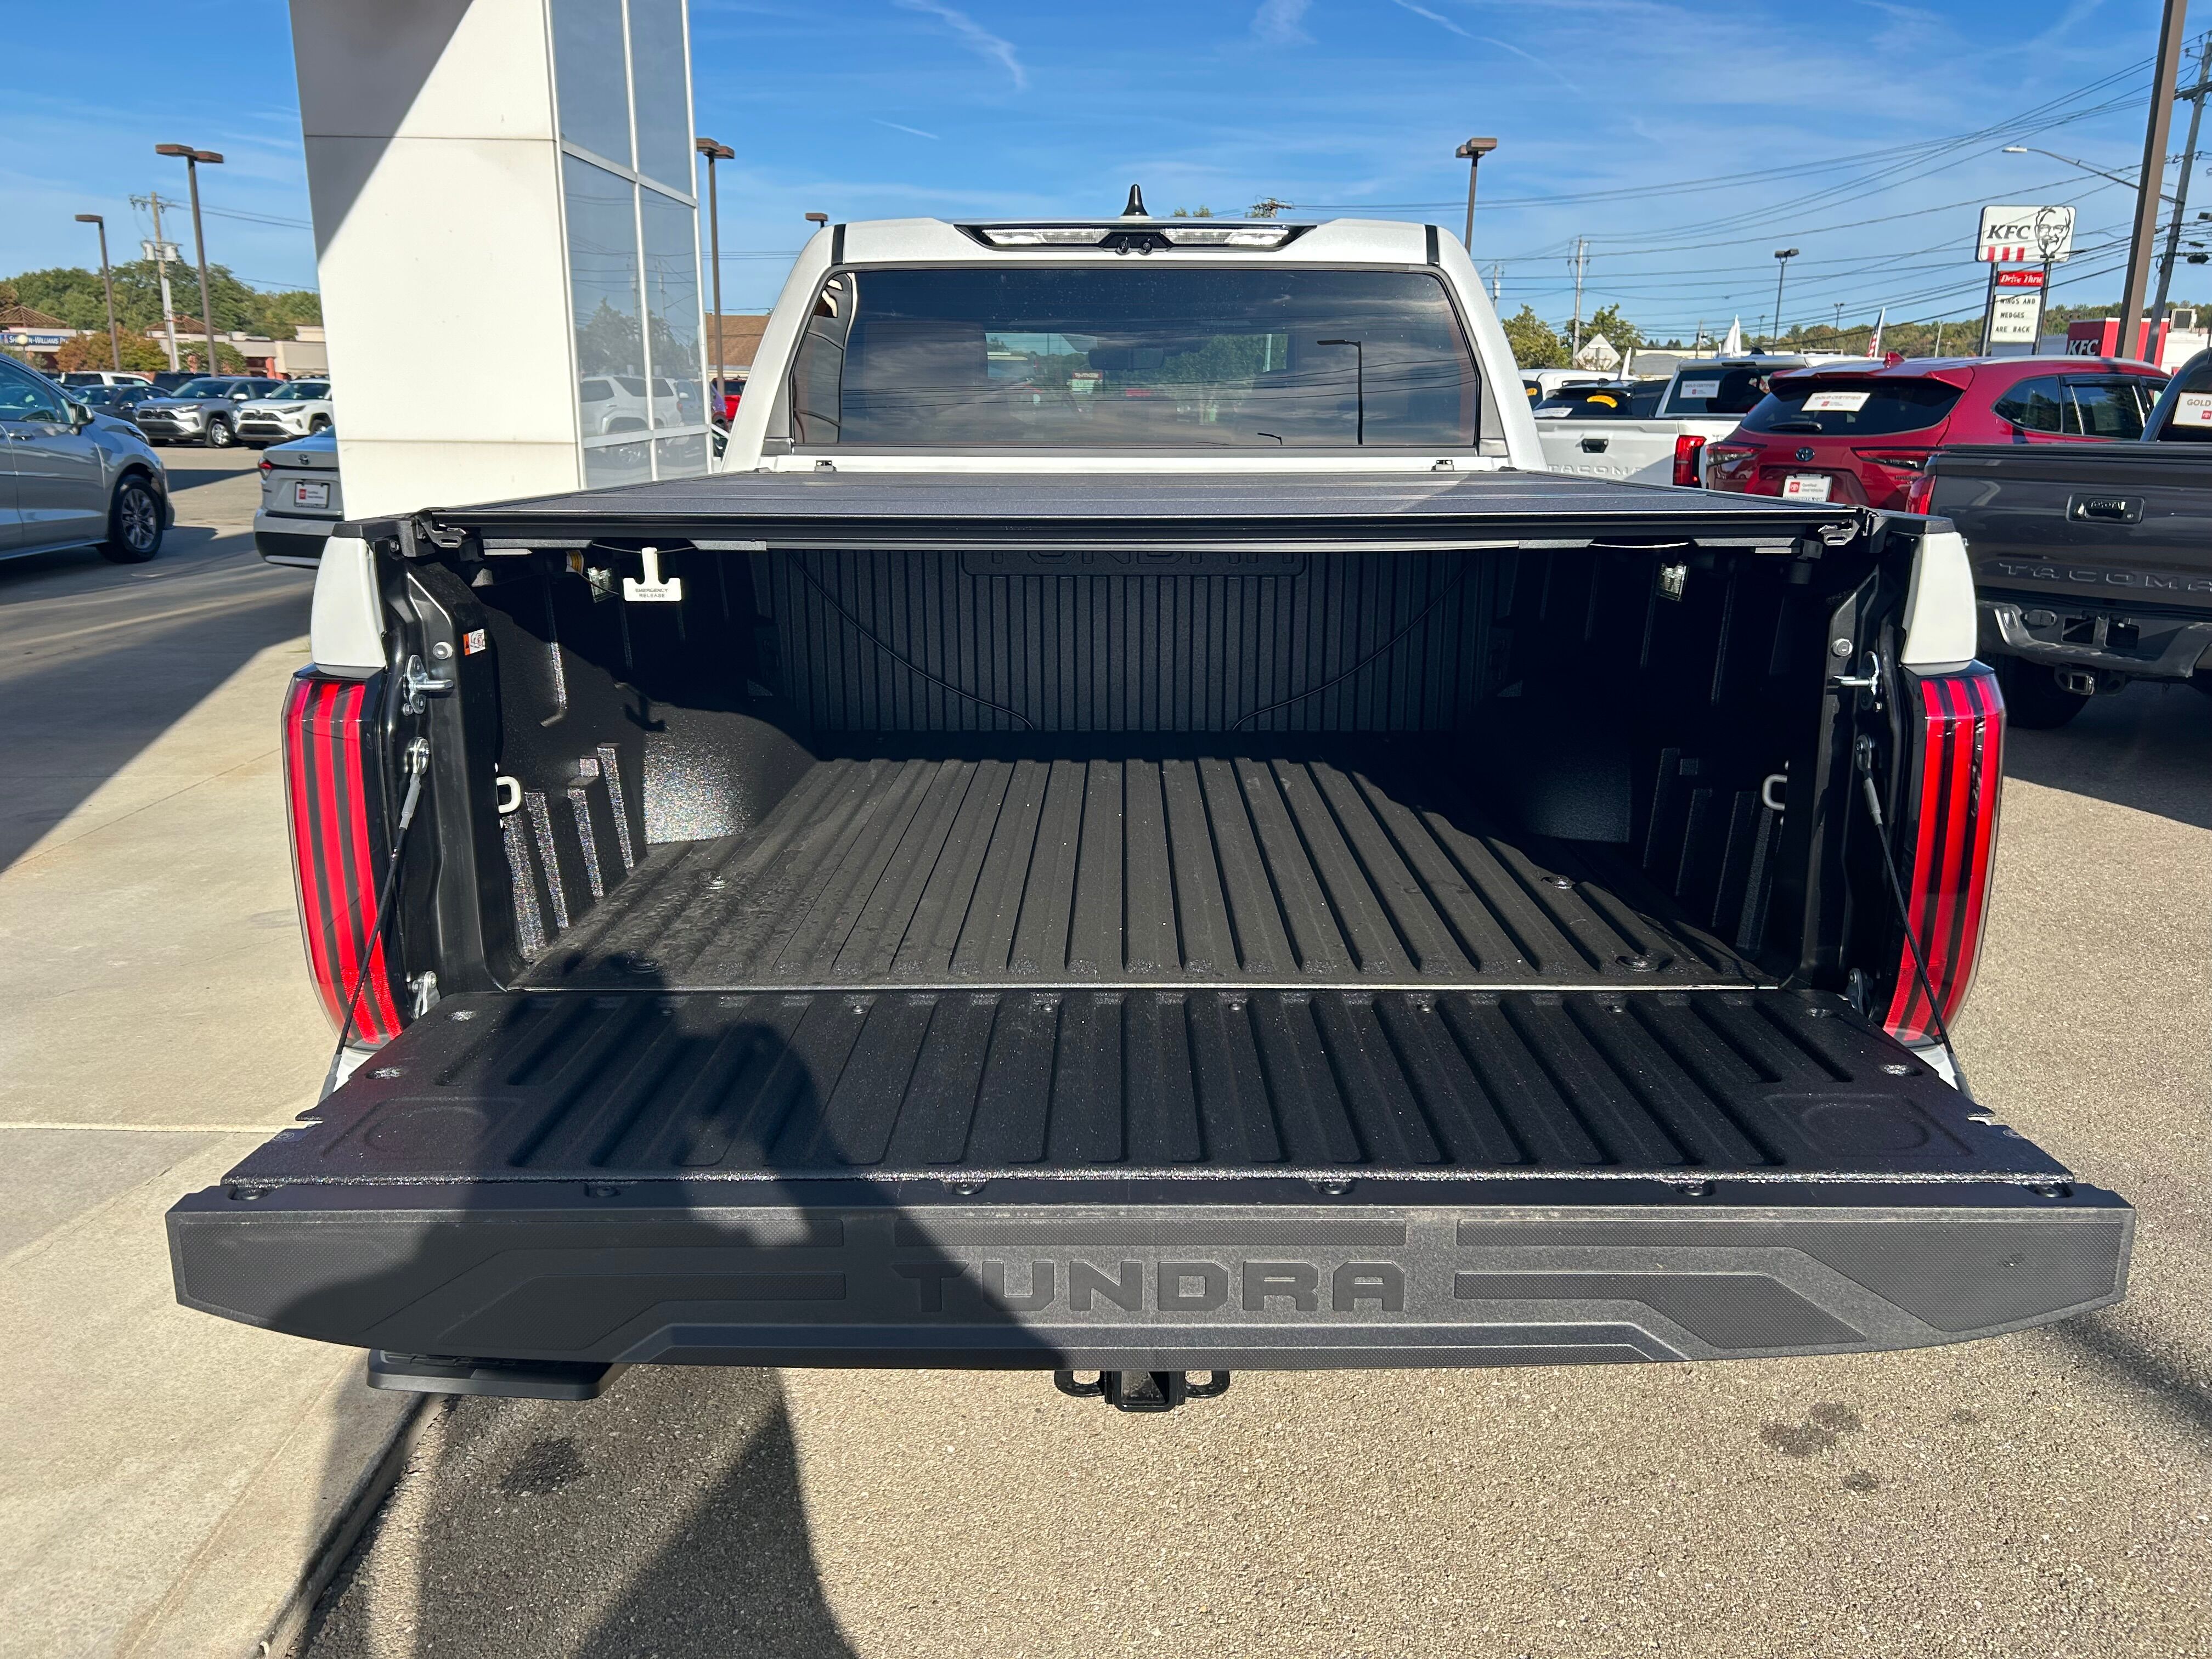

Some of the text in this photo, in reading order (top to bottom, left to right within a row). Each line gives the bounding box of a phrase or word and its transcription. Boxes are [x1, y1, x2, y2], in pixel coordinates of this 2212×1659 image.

[1987, 224, 2031, 239] KFC
[2001, 274, 2042, 283] Drive Thru
[2067, 339, 2099, 356] KFC
[2186, 398, 2211, 407] GOLD
[890, 1260, 1406, 1312] TUNDRA
